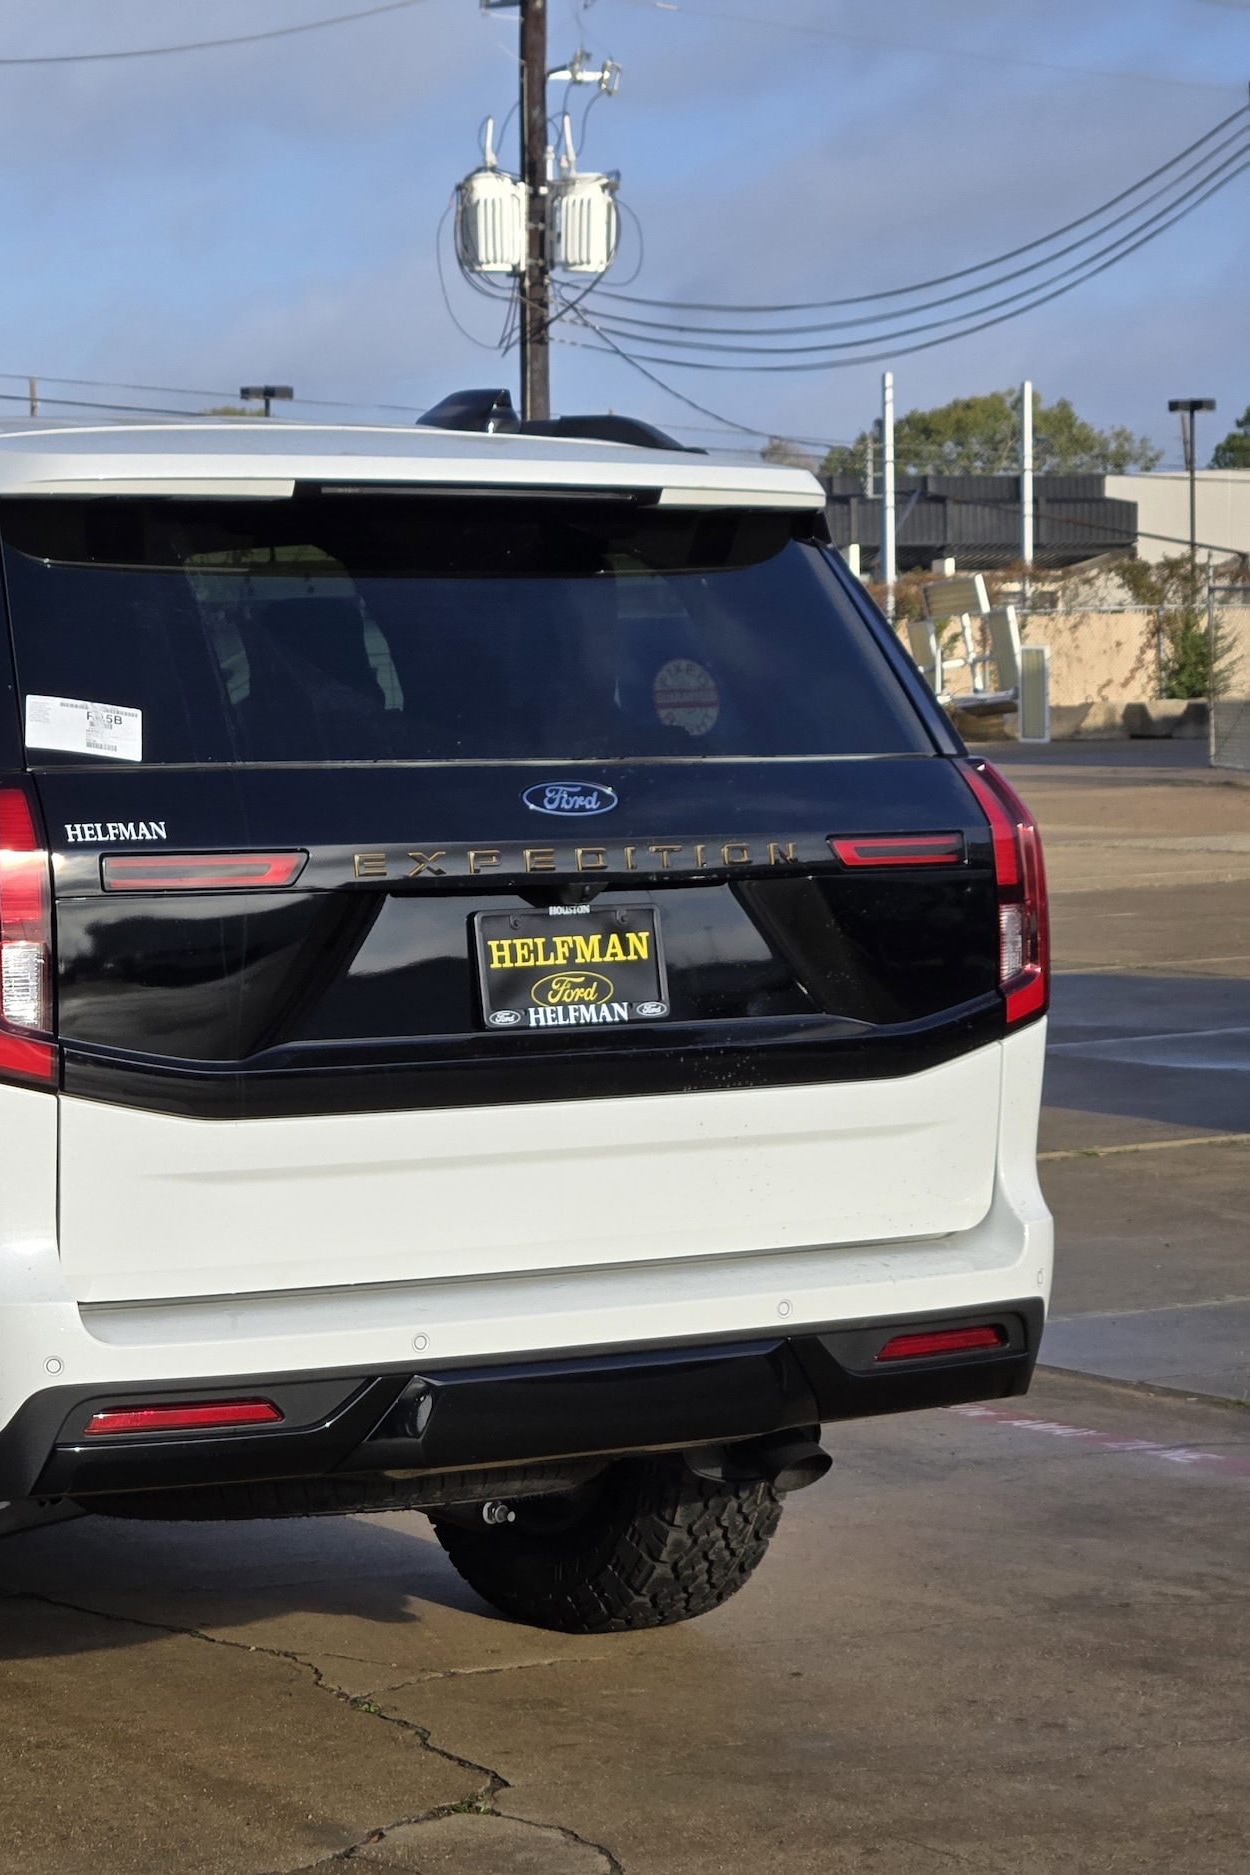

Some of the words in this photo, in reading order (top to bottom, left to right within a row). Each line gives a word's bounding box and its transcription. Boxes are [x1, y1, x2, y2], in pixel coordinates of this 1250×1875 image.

[542, 785, 601, 811] Ford
[64, 821, 168, 842] HELFMAN
[353, 841, 799, 878] EXPEDITION
[548, 904, 591, 916] HOUSTON
[487, 931, 650, 968] HELFMAN
[547, 975, 599, 1004] Ford
[527, 1001, 630, 1027] HELFMAN
